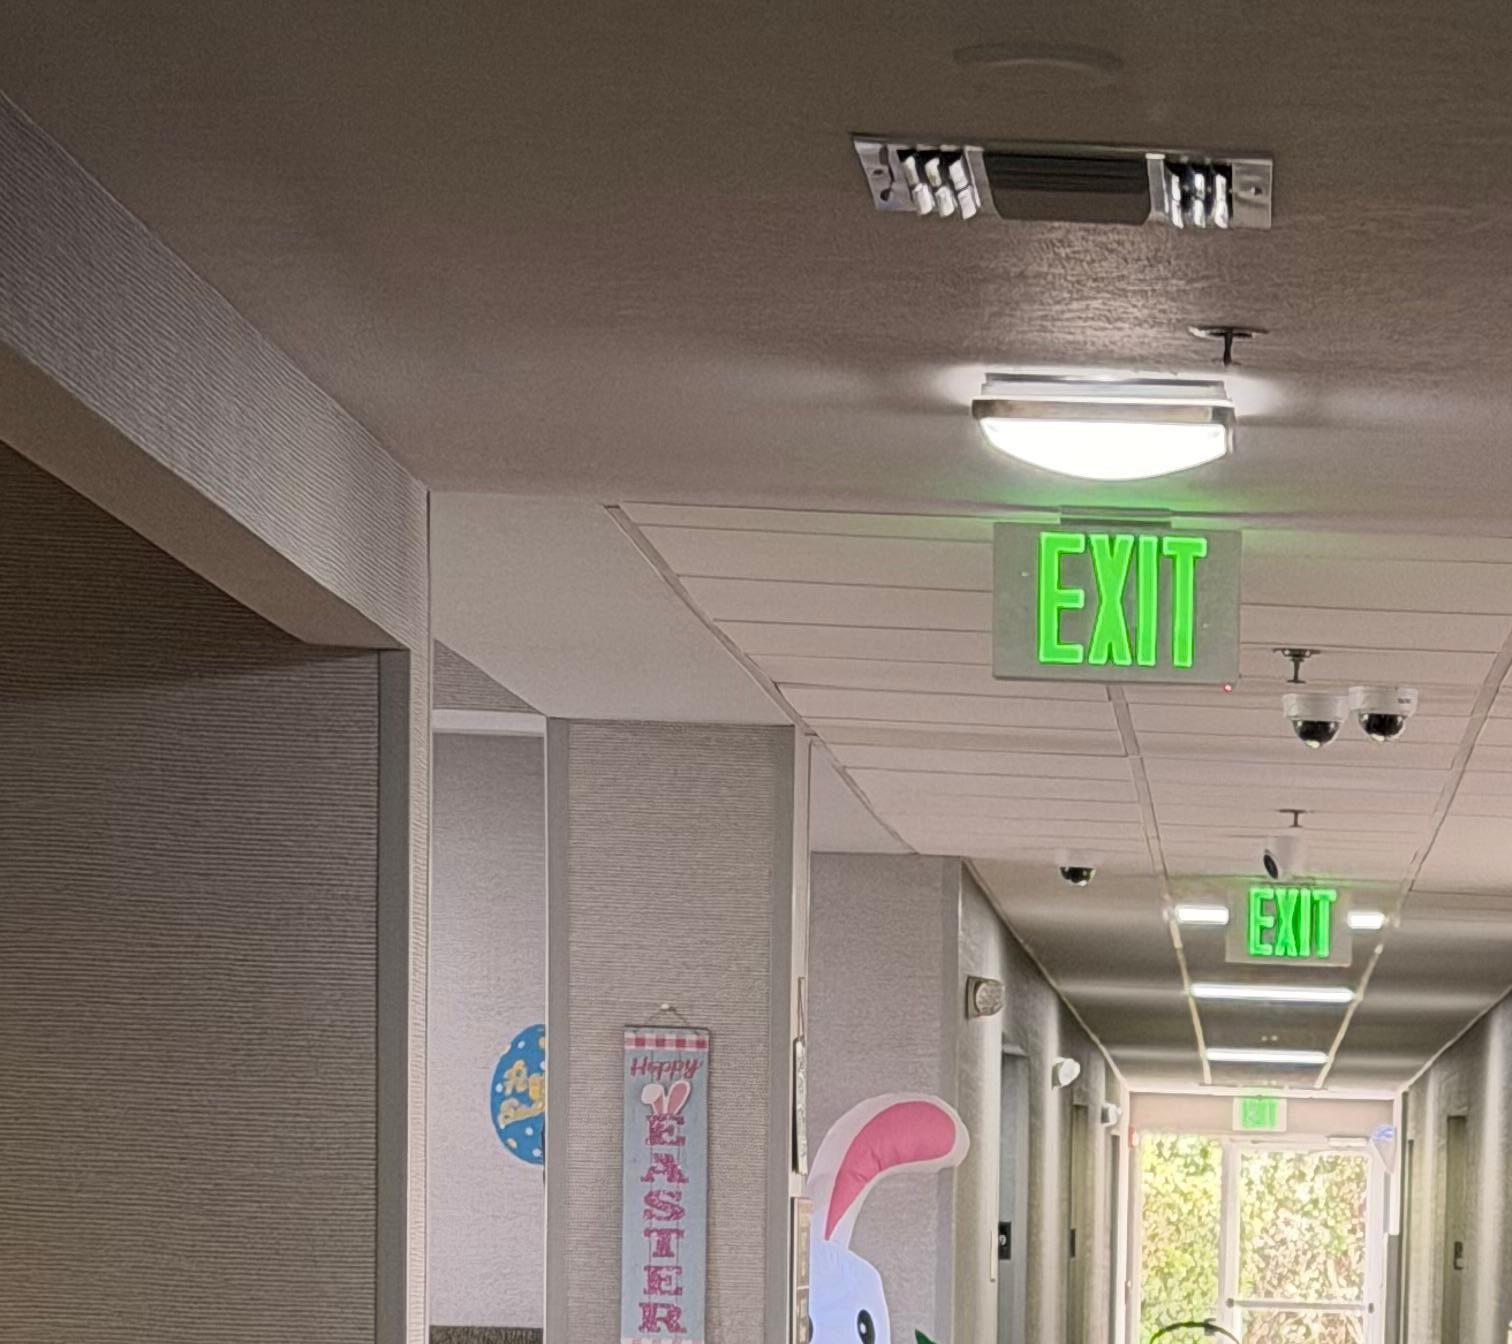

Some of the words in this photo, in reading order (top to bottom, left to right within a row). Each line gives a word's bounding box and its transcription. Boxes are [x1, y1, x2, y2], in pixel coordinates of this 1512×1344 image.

[1038, 531, 1208, 668] EXIT
[1249, 887, 1337, 958] EXIT
[630, 1056, 704, 1081] Happy
[638, 1114, 689, 1334] EASTER
